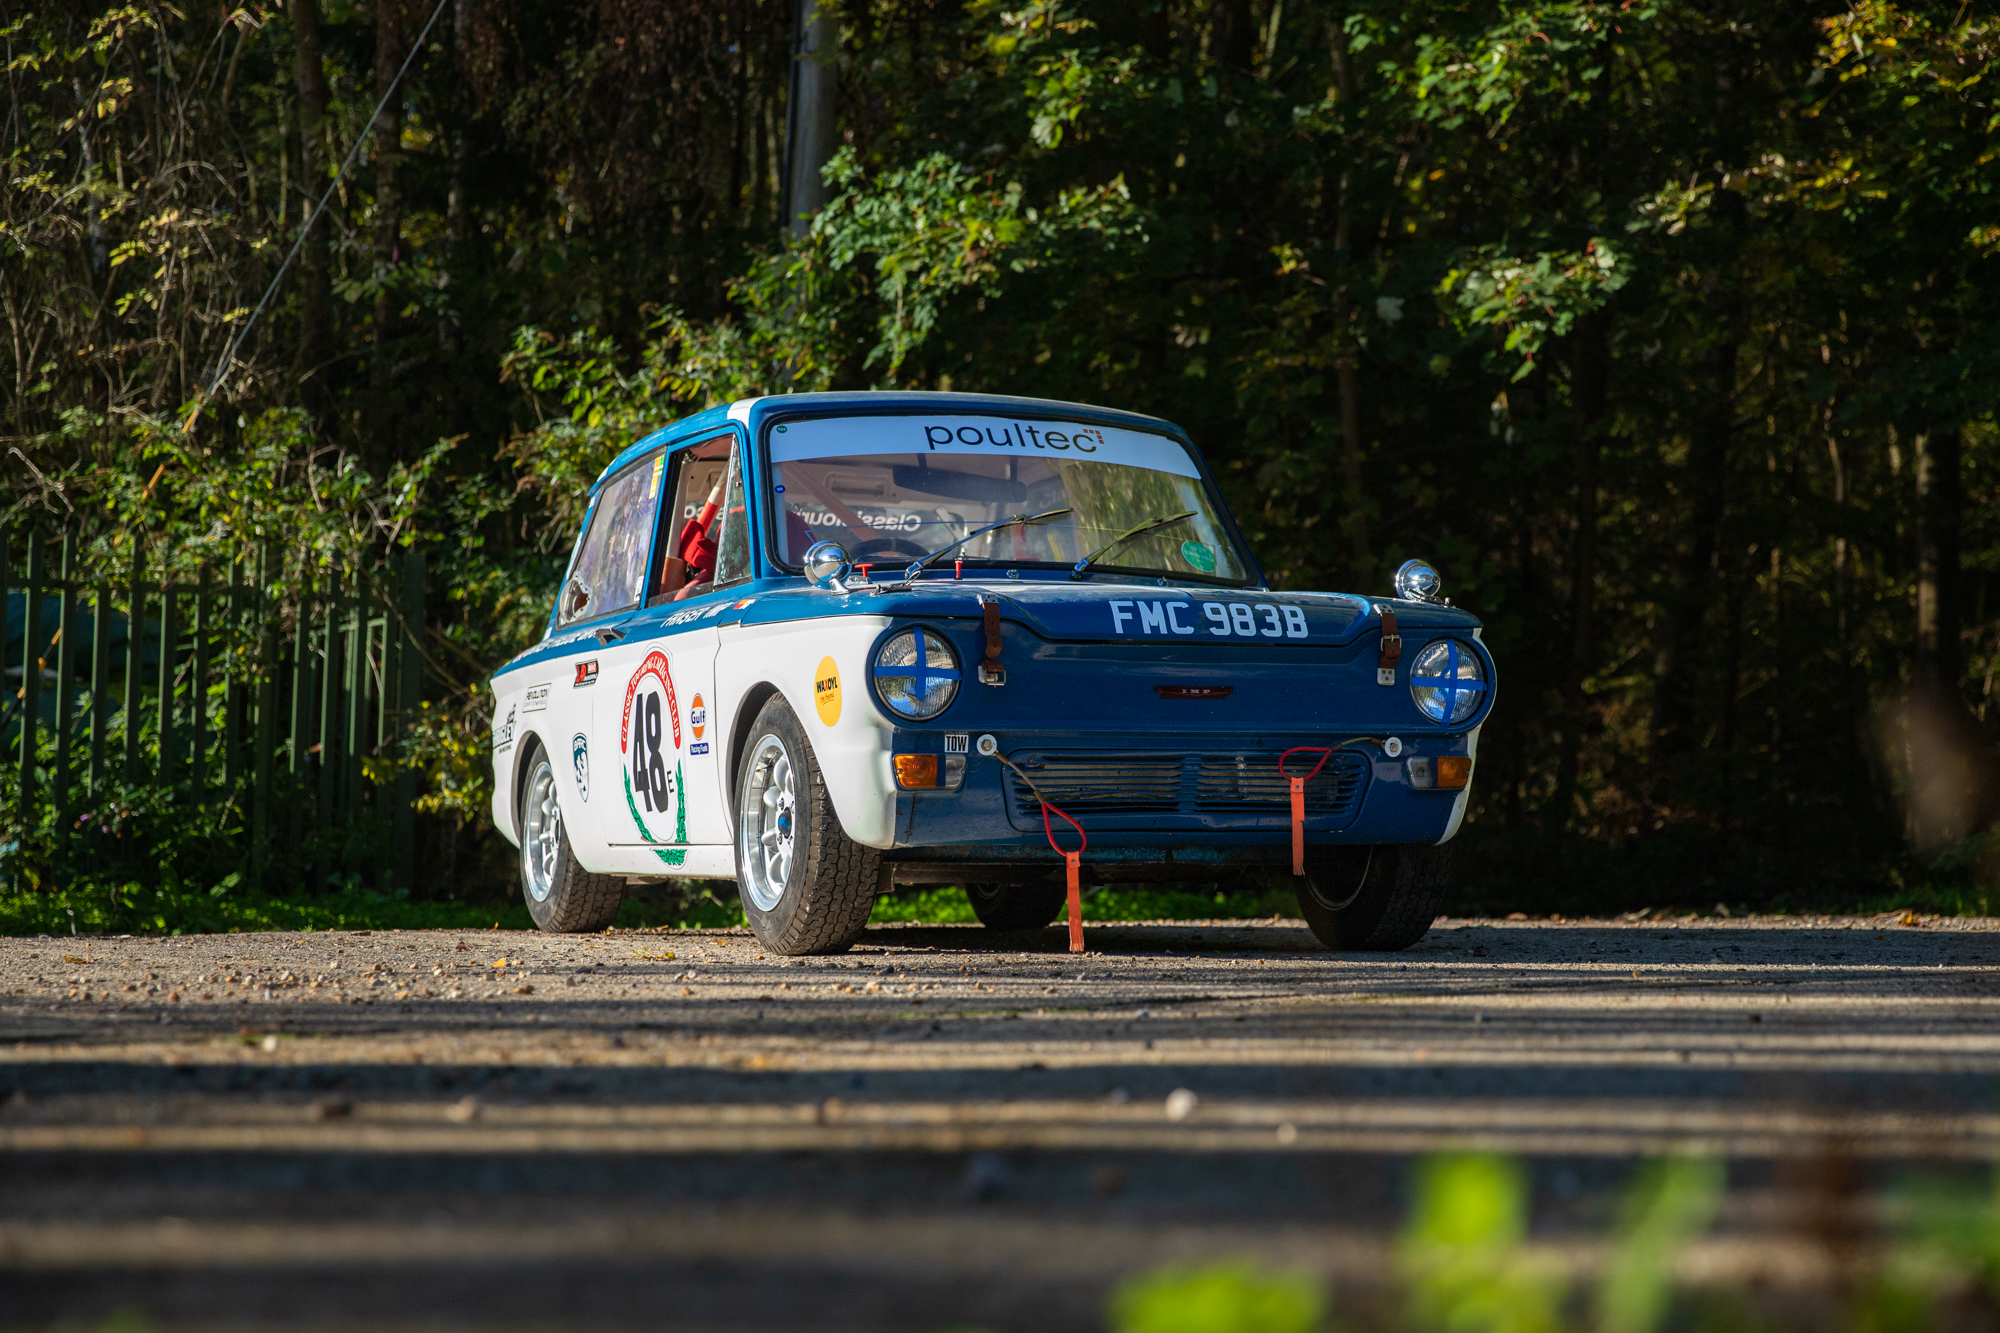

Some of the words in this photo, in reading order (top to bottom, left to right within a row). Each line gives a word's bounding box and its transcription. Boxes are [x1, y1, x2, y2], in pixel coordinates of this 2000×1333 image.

[924, 423, 1097, 453] poultec
[1109, 600, 1194, 635] FMC
[1203, 602, 1309, 638] 983B
[816, 676, 837, 693] WAXOYL
[622, 687, 632, 742] CLASSIC
[671, 699, 679, 738] CLUB
[690, 710, 705, 724] Gulf
[633, 691, 669, 813] 48
[946, 736, 967, 751] TOW
[667, 770, 675, 793] E
